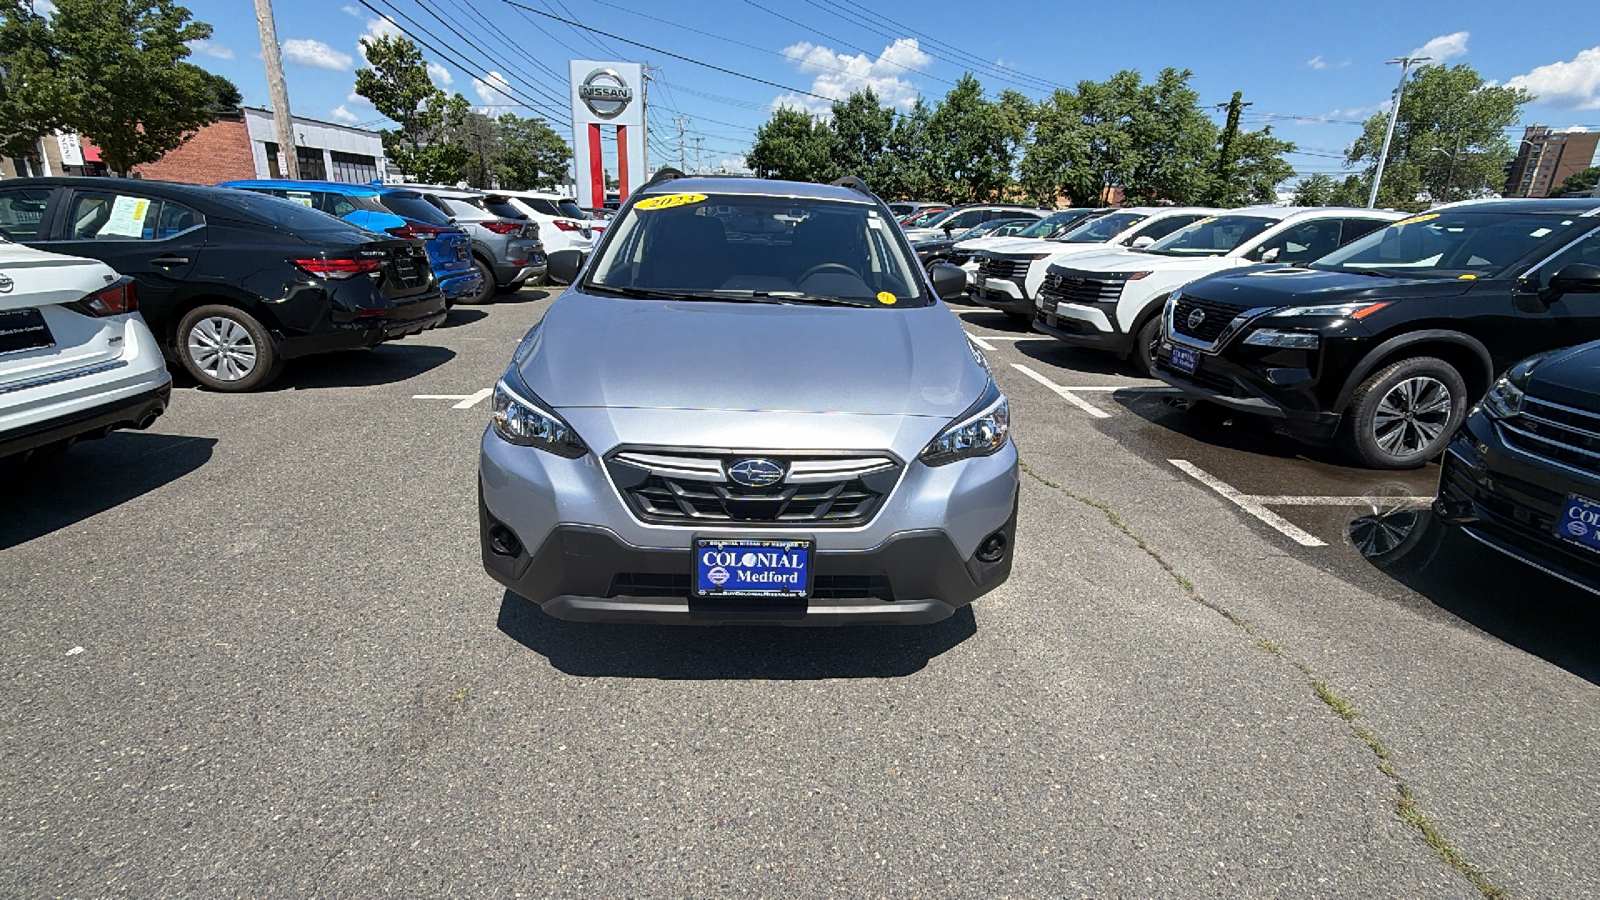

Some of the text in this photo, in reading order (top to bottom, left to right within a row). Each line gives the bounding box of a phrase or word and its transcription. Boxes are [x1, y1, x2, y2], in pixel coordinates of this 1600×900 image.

[583, 87, 627, 98] NISSAN
[649, 195, 696, 208] 2023
[702, 551, 804, 569] COLONIAL
[736, 569, 798, 584] Medford
